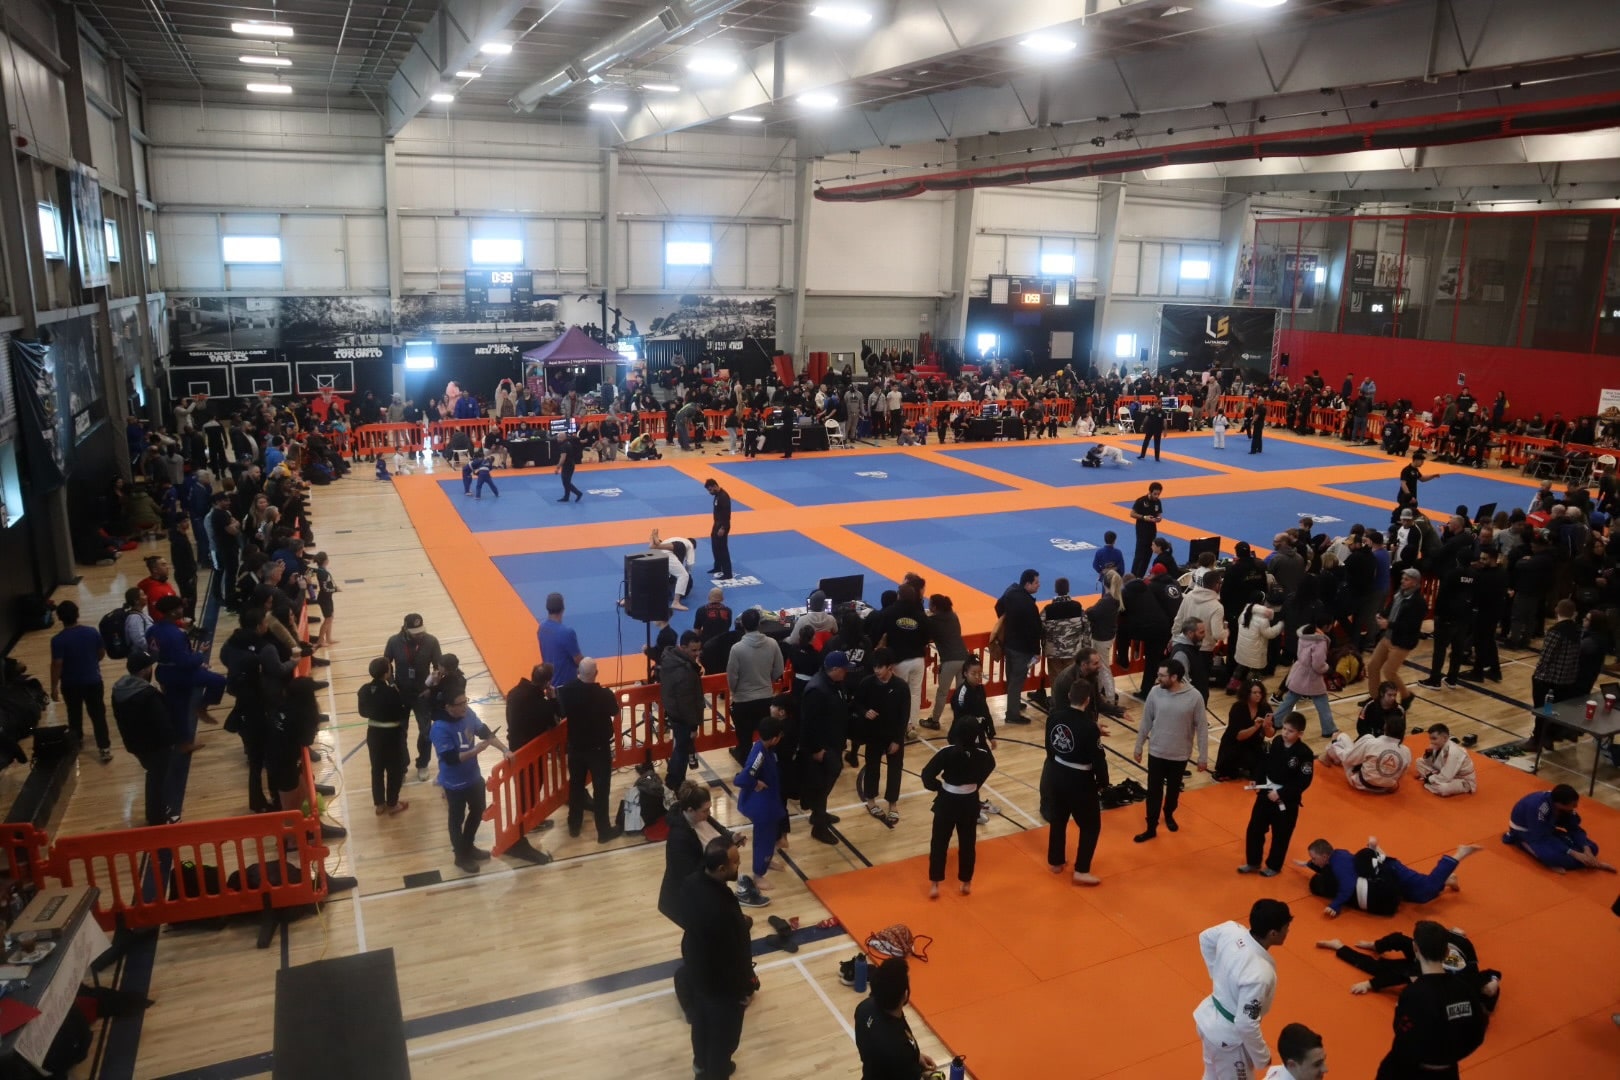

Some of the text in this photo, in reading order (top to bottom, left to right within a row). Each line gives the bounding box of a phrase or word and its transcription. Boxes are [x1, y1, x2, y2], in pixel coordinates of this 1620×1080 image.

[333, 348, 383, 359] TORONTO
[493, 346, 520, 355] YORK
[208, 354, 249, 362] PARIS
[1460, 576, 1474, 584] STAFF
